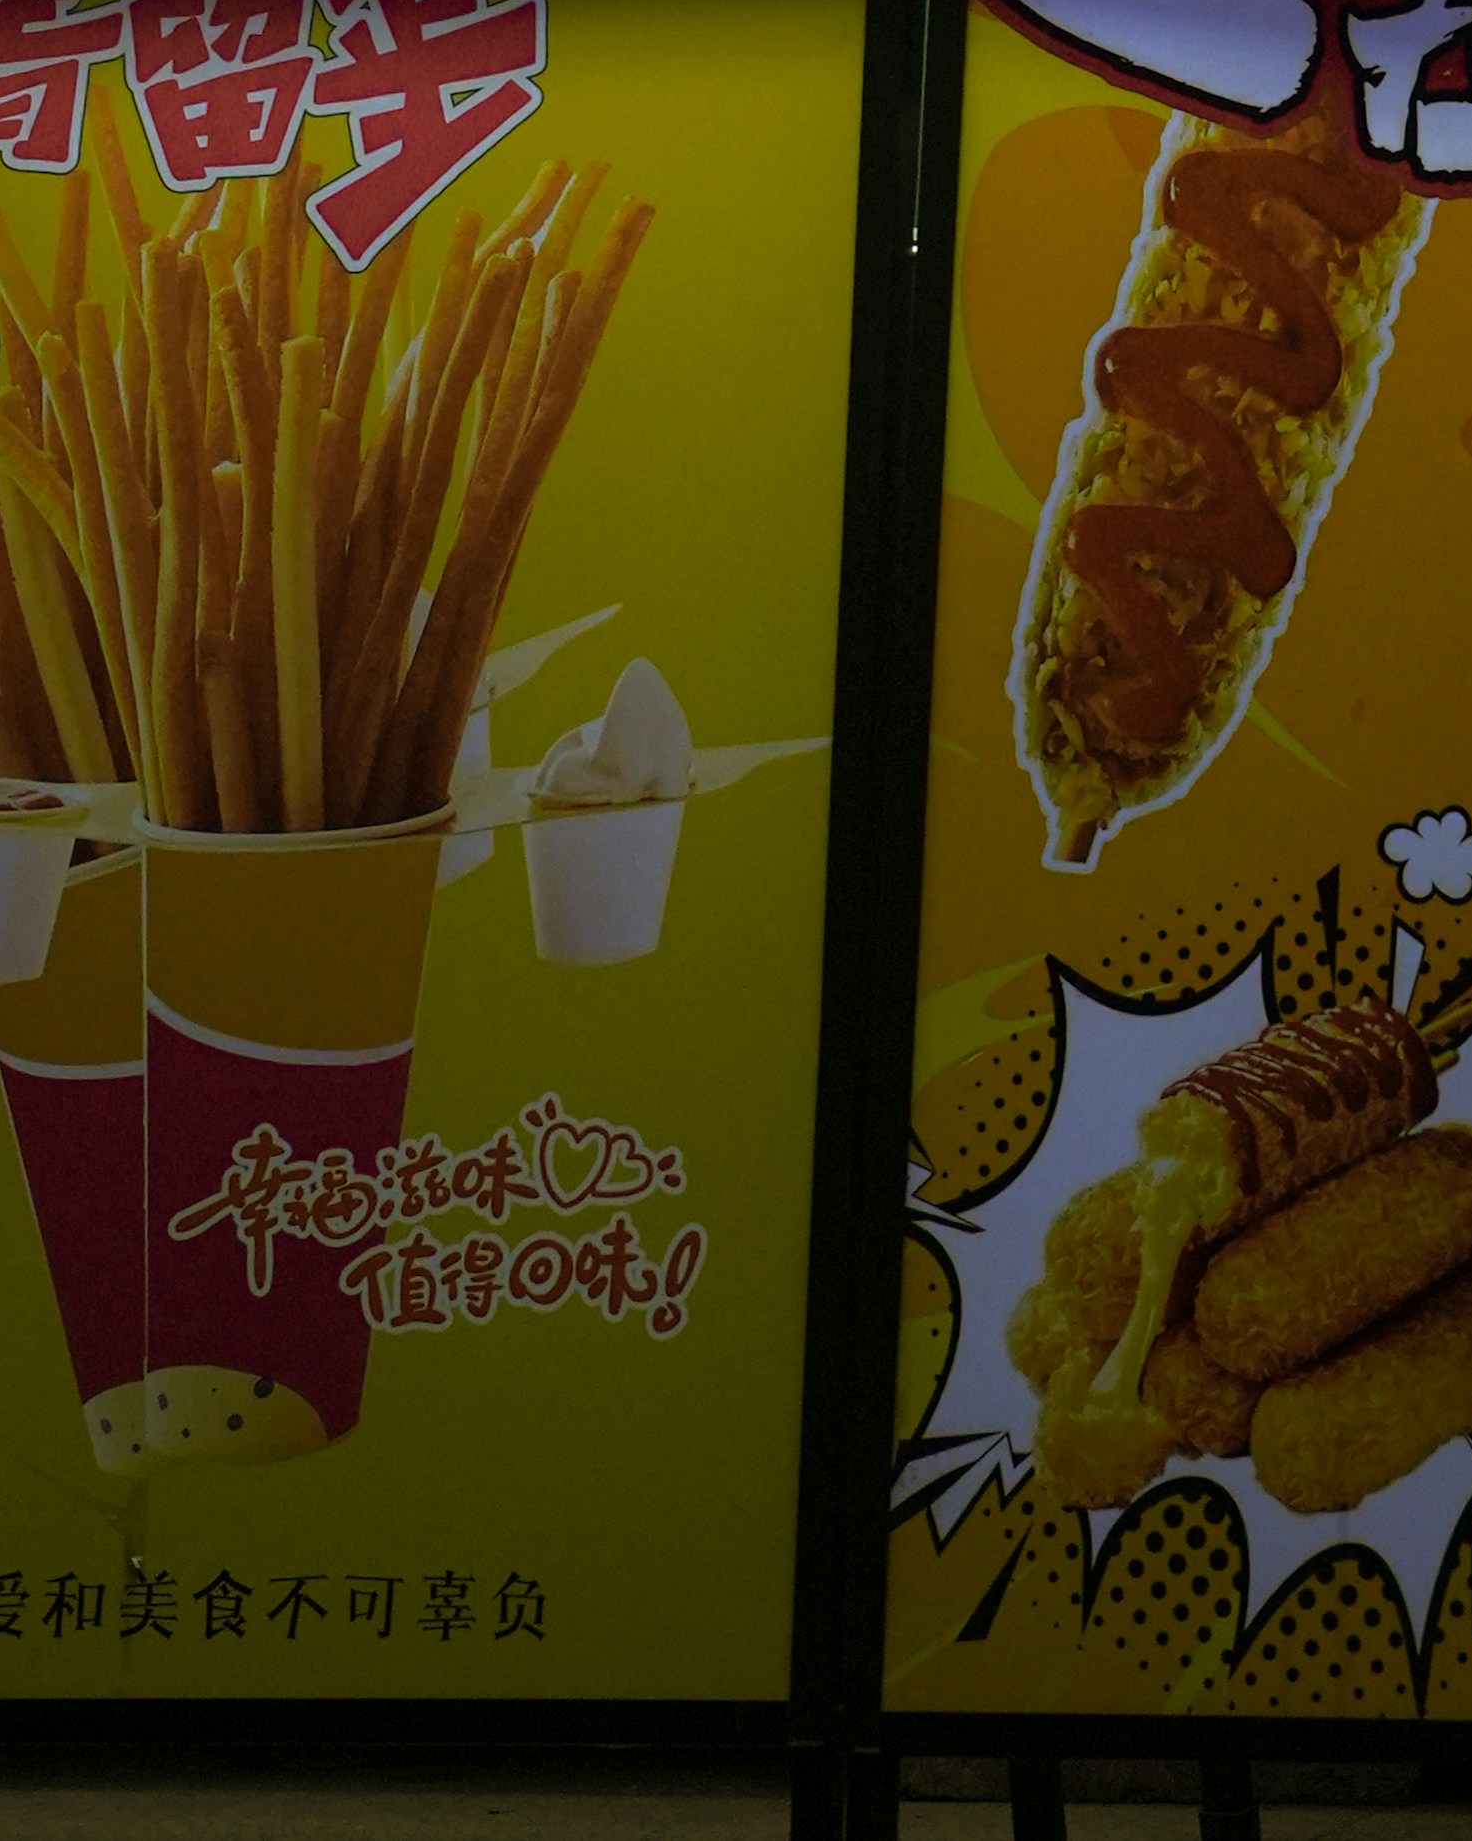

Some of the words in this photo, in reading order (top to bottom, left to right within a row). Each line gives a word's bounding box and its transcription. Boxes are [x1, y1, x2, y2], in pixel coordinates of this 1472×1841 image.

[168, 1123, 541, 1298] 幸福滋味
[344, 1218, 707, 1338] 值得回味!
